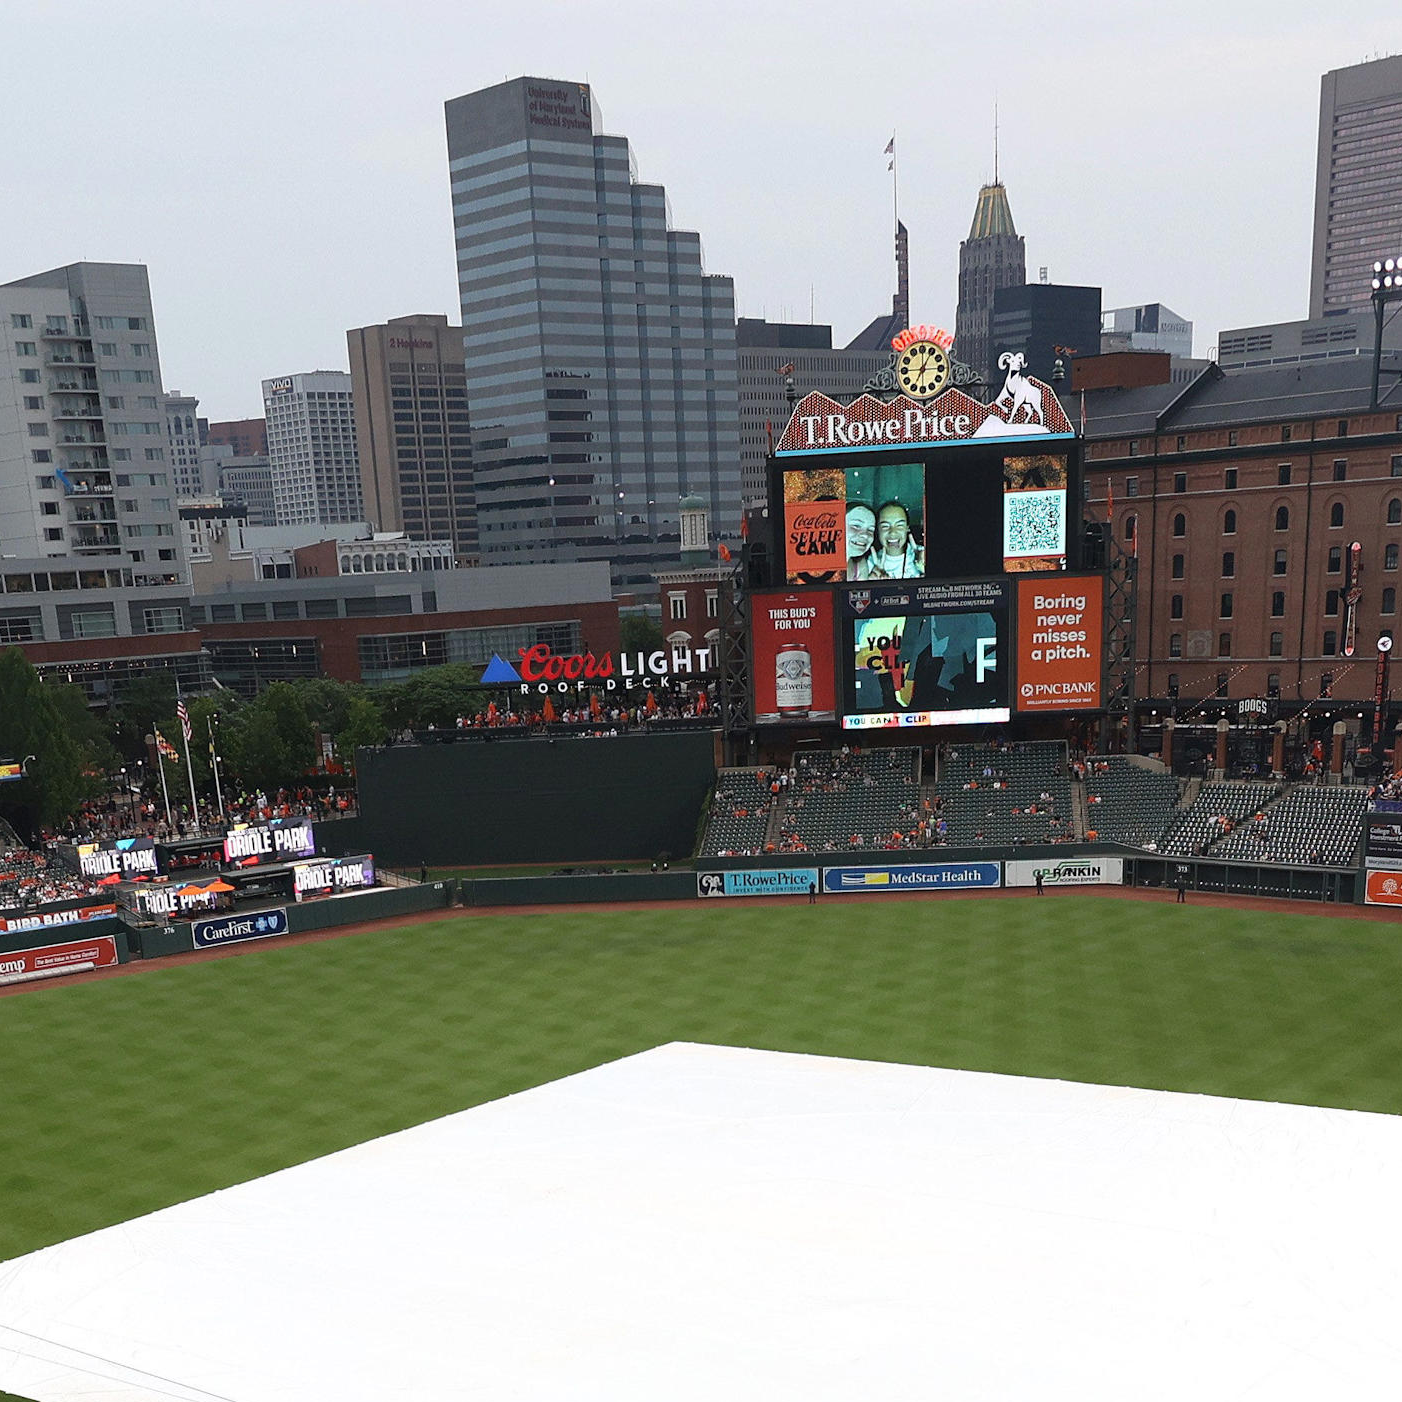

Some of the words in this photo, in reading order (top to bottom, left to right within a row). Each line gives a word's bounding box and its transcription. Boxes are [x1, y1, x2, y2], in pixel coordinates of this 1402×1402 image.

[790, 530, 843, 544] SELFIE
[796, 541, 836, 556] CAM
[1034, 593, 1086, 610] Boring
[768, 608, 789, 619] THIS
[789, 607, 816, 619] BUD'S
[1037, 613, 1082, 626] never
[774, 620, 792, 630] FOR
[793, 619, 811, 629] YOU
[1032, 628, 1086, 643] misses
[1031, 649, 1042, 660] a
[1045, 644, 1091, 663] pitch.
[518, 643, 615, 681] Coors
[620, 648, 711, 676] LIGHT
[520, 680, 585, 695] ROOF
[606, 676, 670, 691] DECK
[905, 715, 927, 724] CLIP
[227, 831, 273, 858] ORIOLE
[275, 825, 310, 852] PARK
[122, 848, 156, 872] PARK
[334, 862, 364, 887] PARK
[891, 872, 940, 885] MedStar
[943, 869, 982, 882] Health
[6, 914, 40, 931] BIRD
[44, 910, 79, 926] BATH
[163, 927, 175, 935] 376
[203, 920, 255, 943] CareFirst
